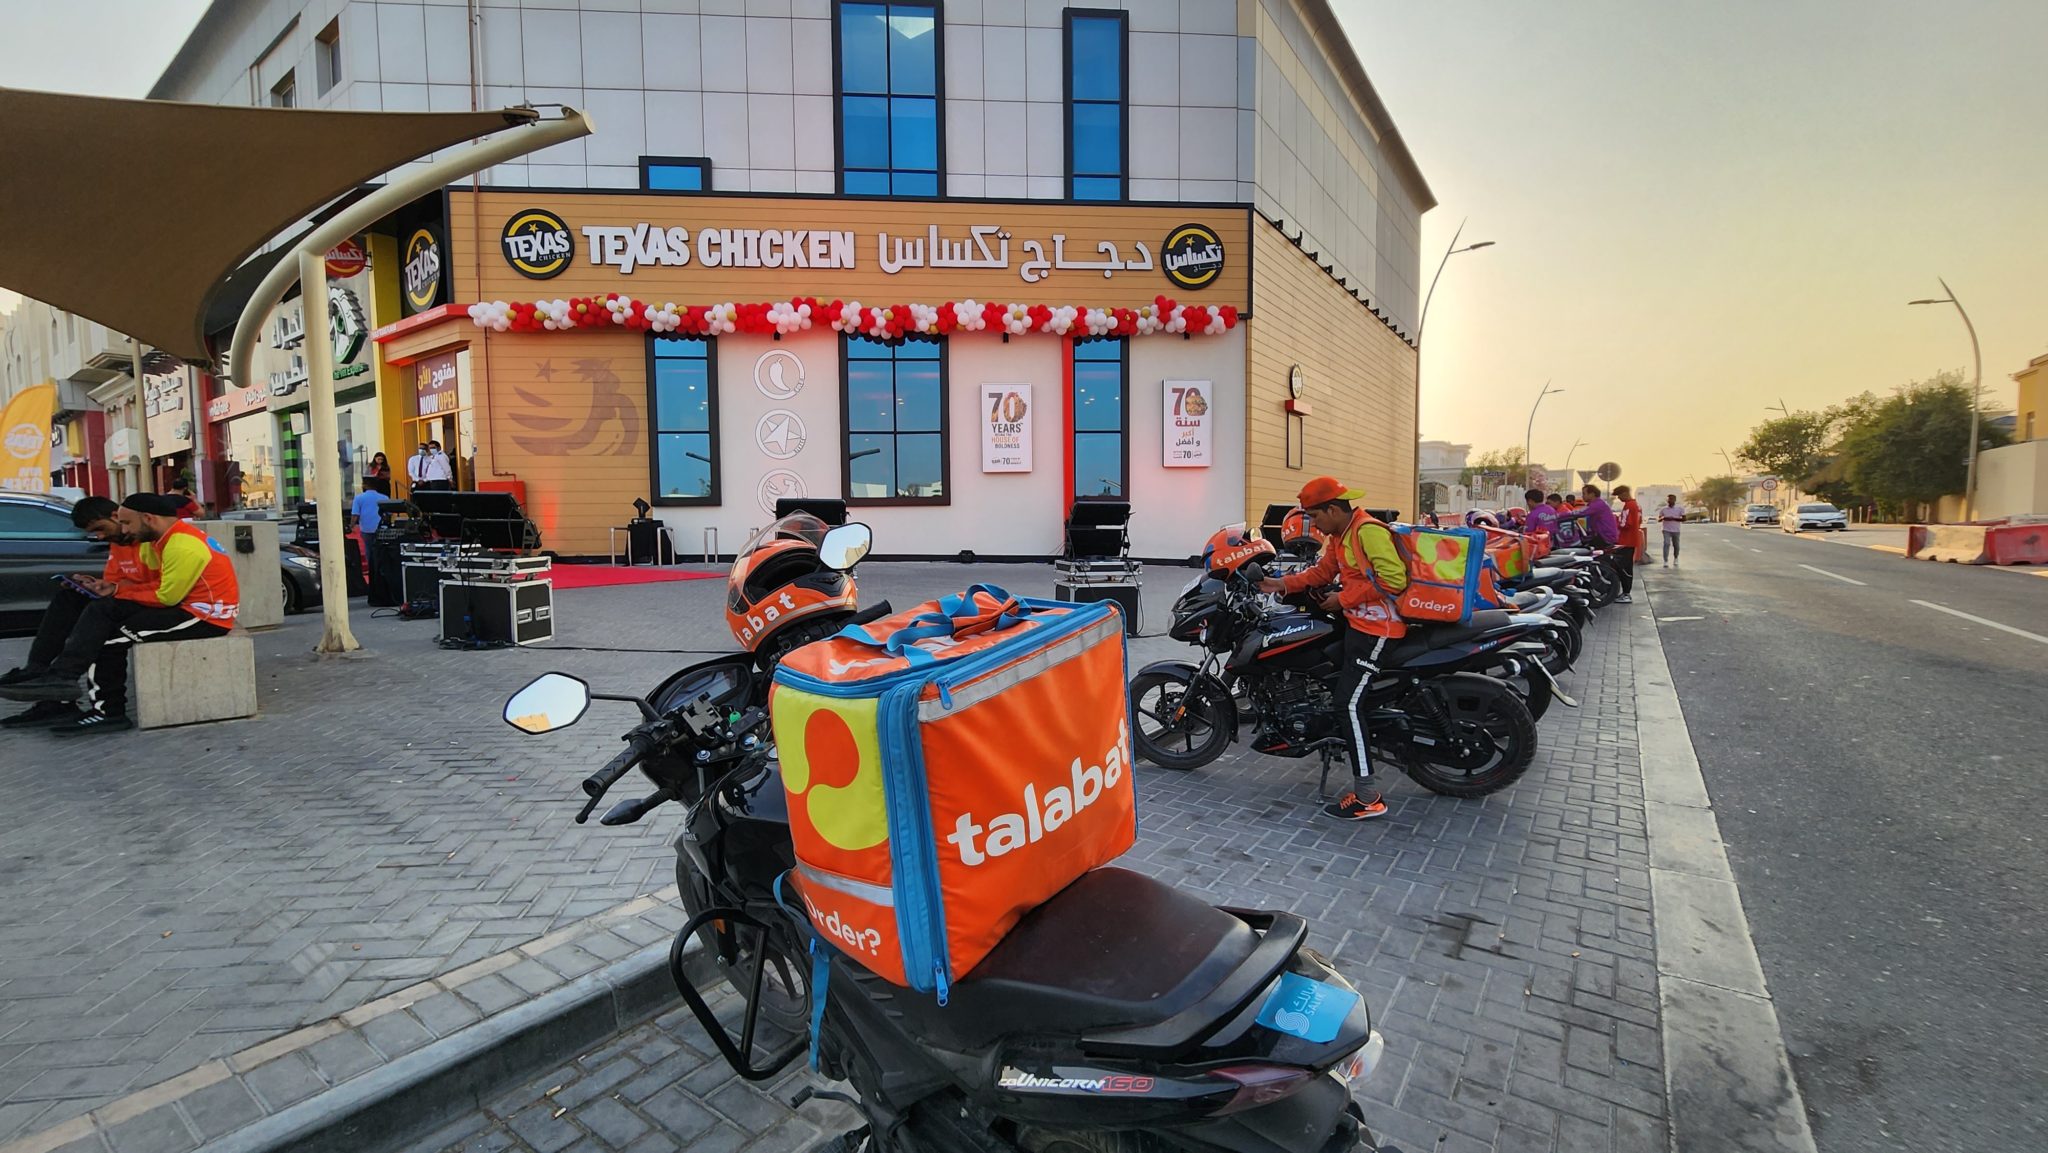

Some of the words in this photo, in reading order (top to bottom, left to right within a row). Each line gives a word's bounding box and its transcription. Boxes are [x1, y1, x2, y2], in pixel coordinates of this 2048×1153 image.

[505, 230, 570, 262] TEXAS
[538, 252, 571, 262] CHICKEN
[582, 223, 691, 274] TEXAS
[697, 228, 855, 269] CHICKEN
[879, 225, 1012, 274] تكساس
[1020, 234, 1153, 283] دجاج
[1165, 244, 1222, 271] تكساس
[405, 243, 439, 292] TEXAS
[420, 393, 438, 416] NOW
[988, 391, 1027, 423] 70
[992, 423, 1022, 433] YEARS
[1175, 417, 1200, 427] سنة
[991, 436, 1011, 444] HOUSE
[1182, 450, 1192, 459] 70
[1216, 543, 1267, 567] talabat
[1409, 597, 1456, 614] Order?
[947, 717, 1129, 867] talabat
